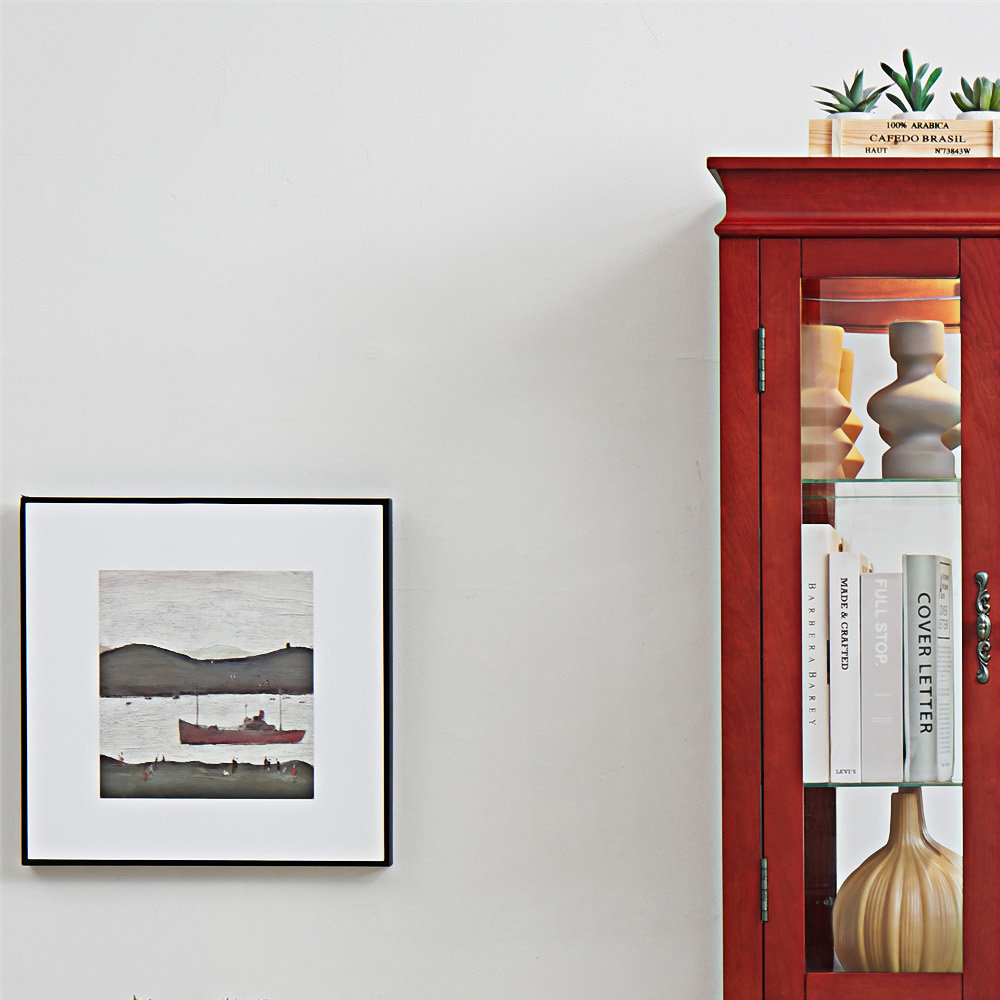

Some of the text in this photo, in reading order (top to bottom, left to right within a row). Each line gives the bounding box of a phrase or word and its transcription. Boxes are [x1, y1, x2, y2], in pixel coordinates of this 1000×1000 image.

[922, 135, 967, 143] BRASIL
[840, 577, 849, 671] MADE & CRAFTED
[874, 578, 888, 666] FULL STOP.
[917, 592, 933, 734] COVER LETTER
